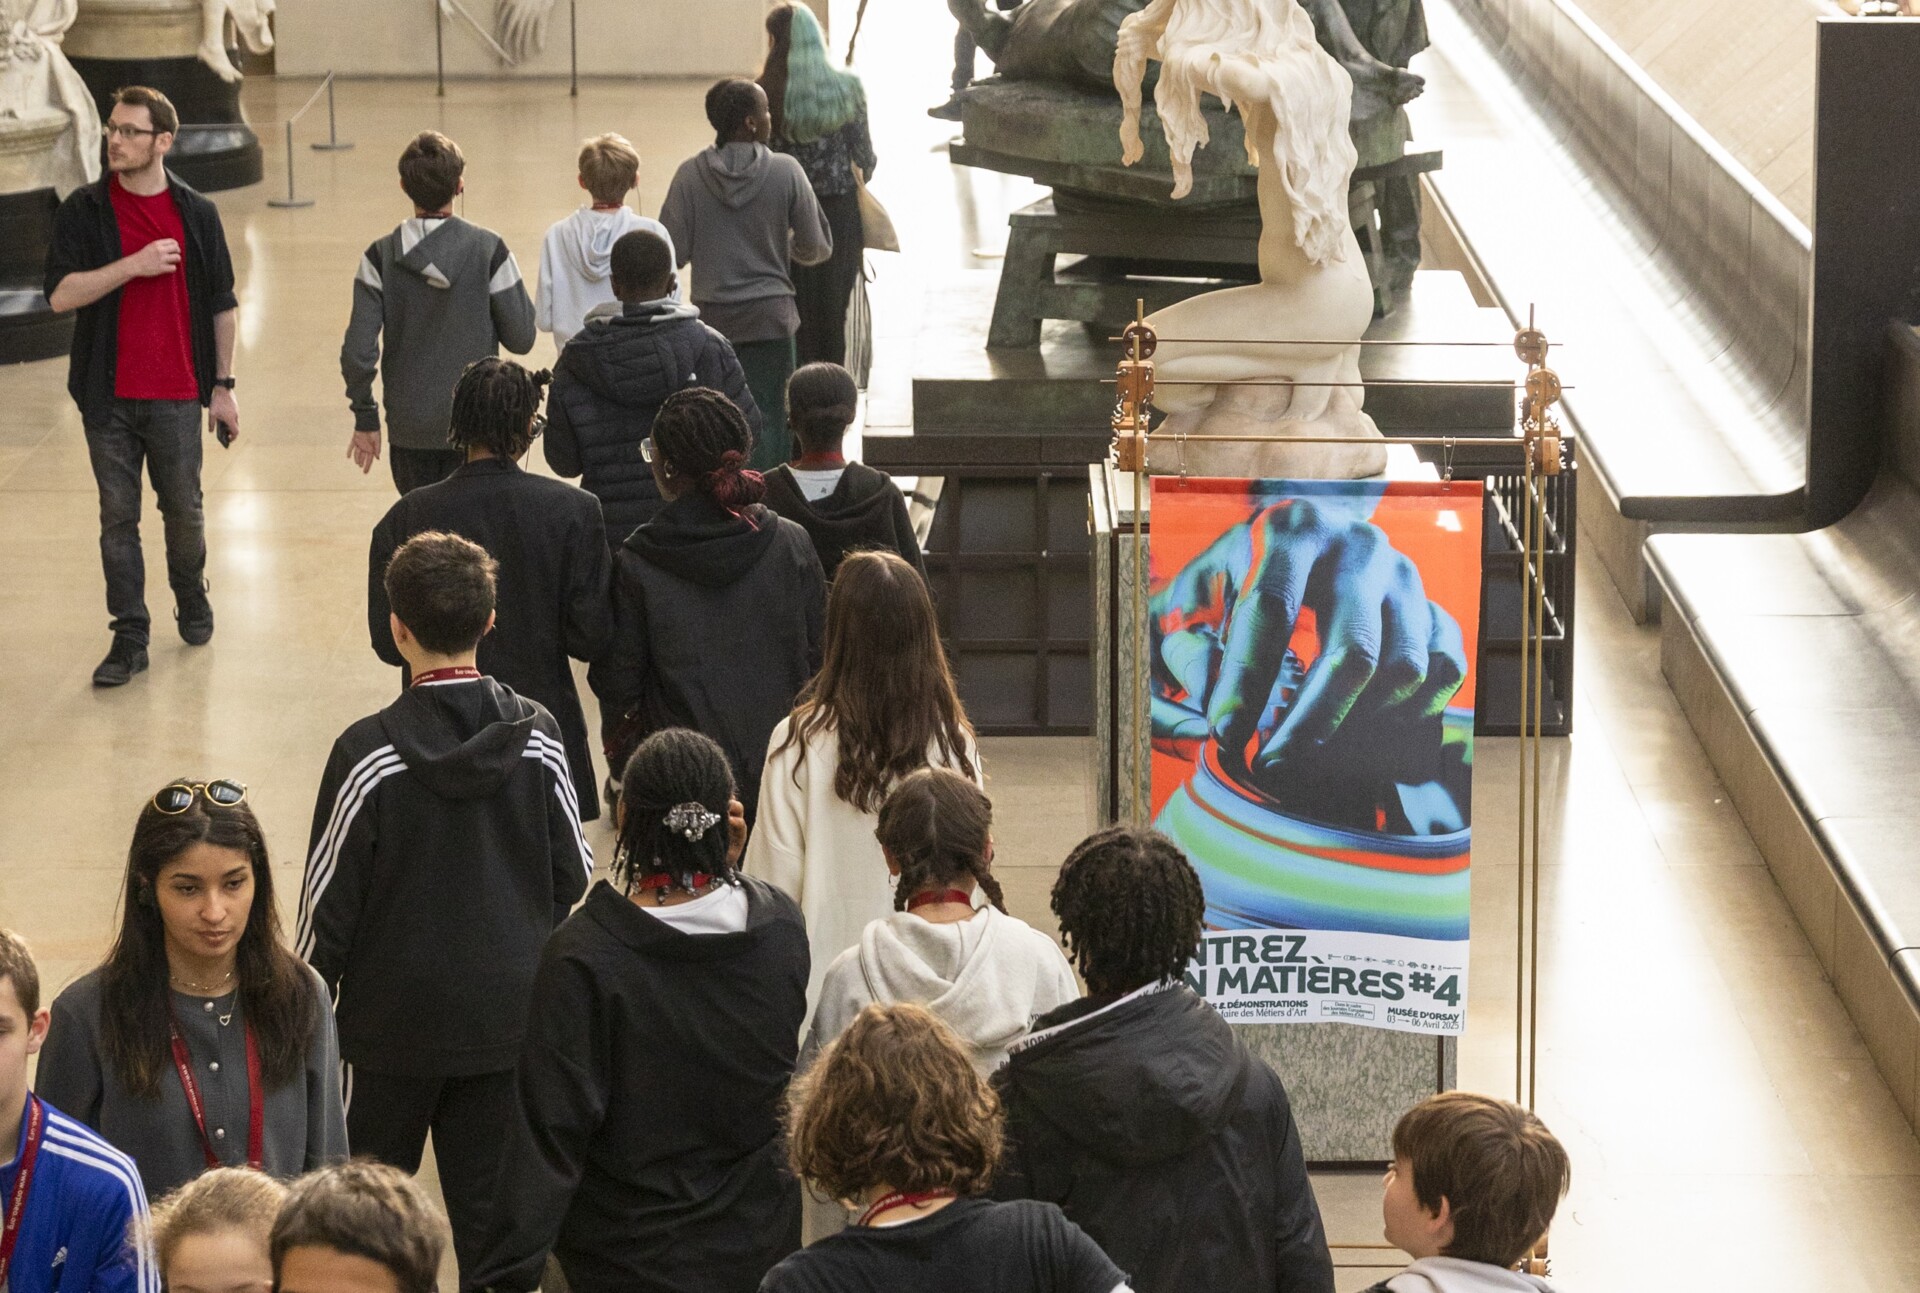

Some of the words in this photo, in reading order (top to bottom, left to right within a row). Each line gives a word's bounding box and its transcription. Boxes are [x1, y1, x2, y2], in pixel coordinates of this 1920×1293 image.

[1187, 935, 1307, 967] NTREZ
[1184, 969, 1207, 998] N
[1217, 956, 1405, 1001] MATIÈRES
[1409, 972, 1461, 1007] #4
[1227, 999, 1308, 1009] DÉMONSTRATIONS
[1240, 1008, 1254, 1017] des
[1256, 1007, 1285, 1017] Métiers
[1286, 1007, 1307, 1017] d'Art
[1387, 1006, 1419, 1018] MUSÉE
[1420, 1011, 1460, 1022] D'ORSAY
[1387, 1015, 1396, 1024] 03
[1411, 1018, 1421, 1027] 06
[1422, 1020, 1440, 1029] Avril
[1441, 1021, 1459, 1030] 2025
[7, 1169, 27, 1231] www.orpheo.org
